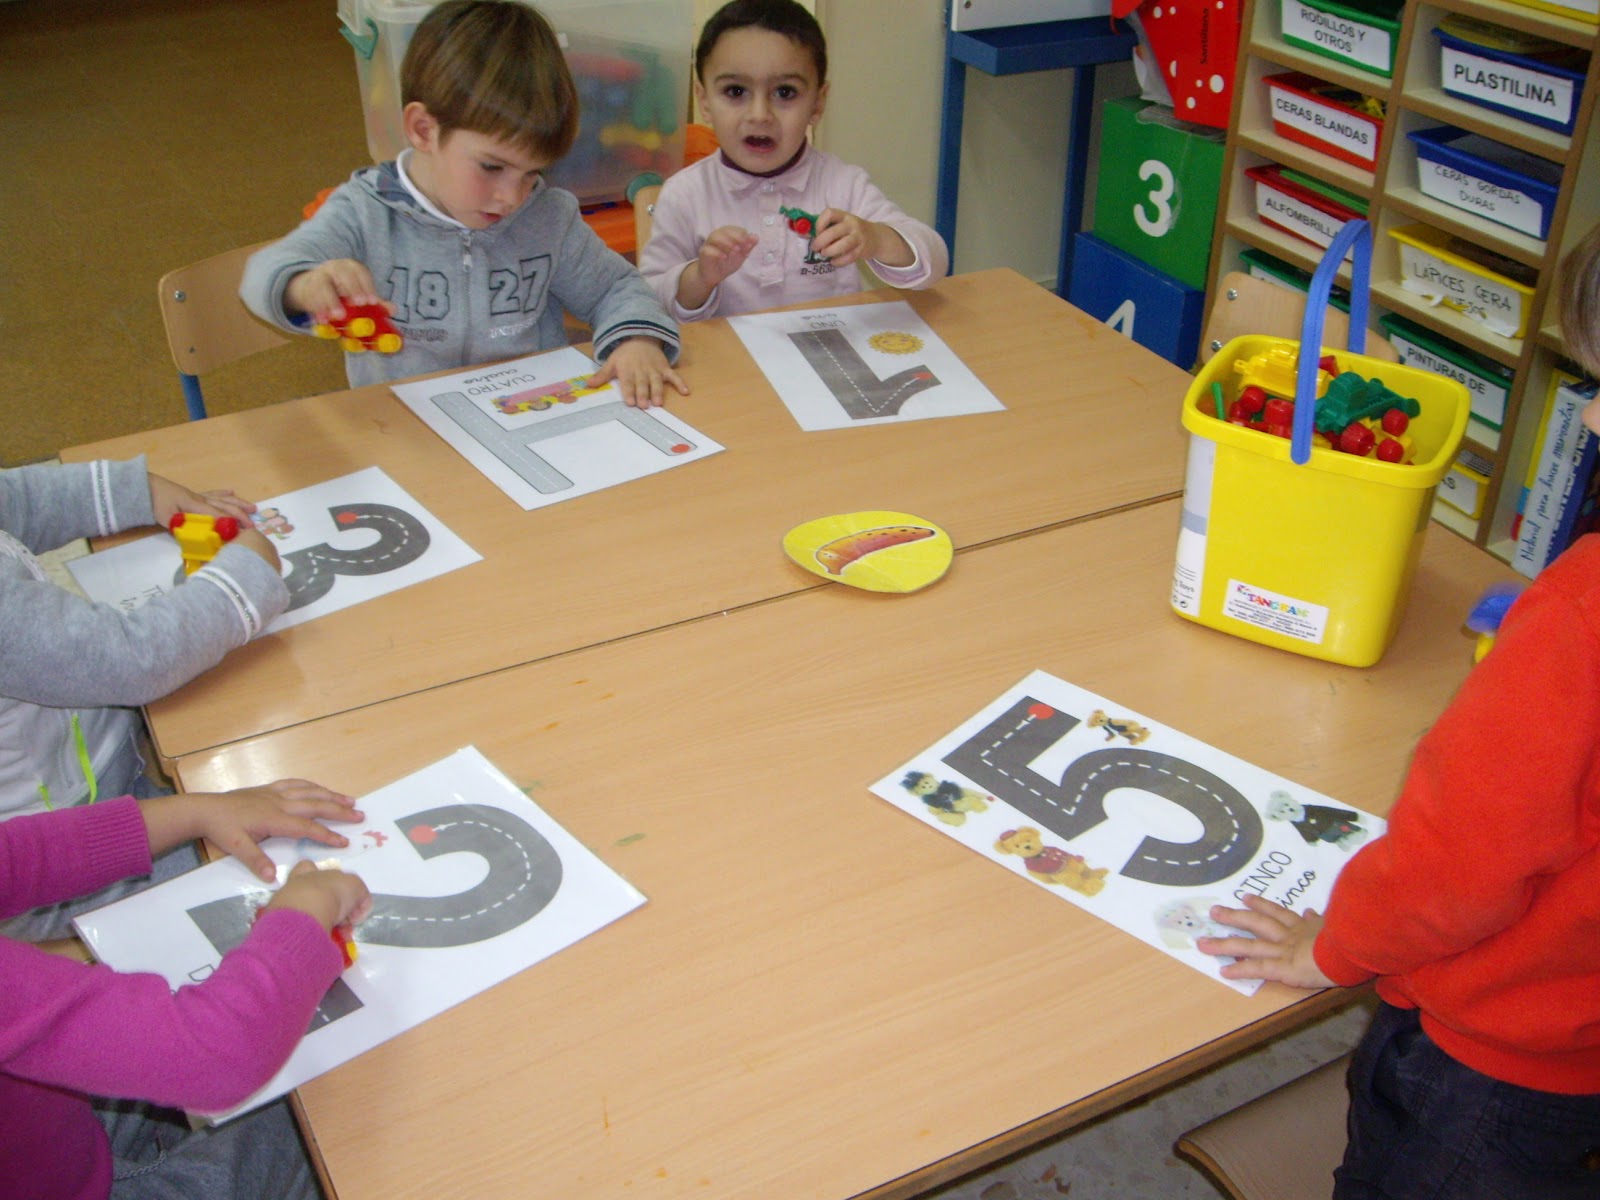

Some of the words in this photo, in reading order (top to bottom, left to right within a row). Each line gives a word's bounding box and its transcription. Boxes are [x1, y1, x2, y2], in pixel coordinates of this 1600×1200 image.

[1300, 8, 1356, 38] RODILLOS
[1358, 30, 1366, 41] Y
[1314, 30, 1353, 53] OTROS
[1453, 64, 1556, 106] PLASTILINA
[1276, 98, 1313, 121] CERAS
[1314, 114, 1369, 144] BLANDAS
[1133, 159, 1175, 238] 3
[1434, 165, 1469, 186] CERAS
[1477, 181, 1521, 204] GORDAS
[1459, 190, 1496, 211] DURAS
[387, 266, 450, 323] 18
[489, 254, 551, 316] 27
[1474, 285, 1512, 311] CERA
[810, 320, 846, 330] UNO
[467, 374, 537, 396] CUATRO
[1407, 347, 1466, 384] PINTURAS
[1469, 378, 1487, 395] DE
[1275, 869, 1316, 909] inco
